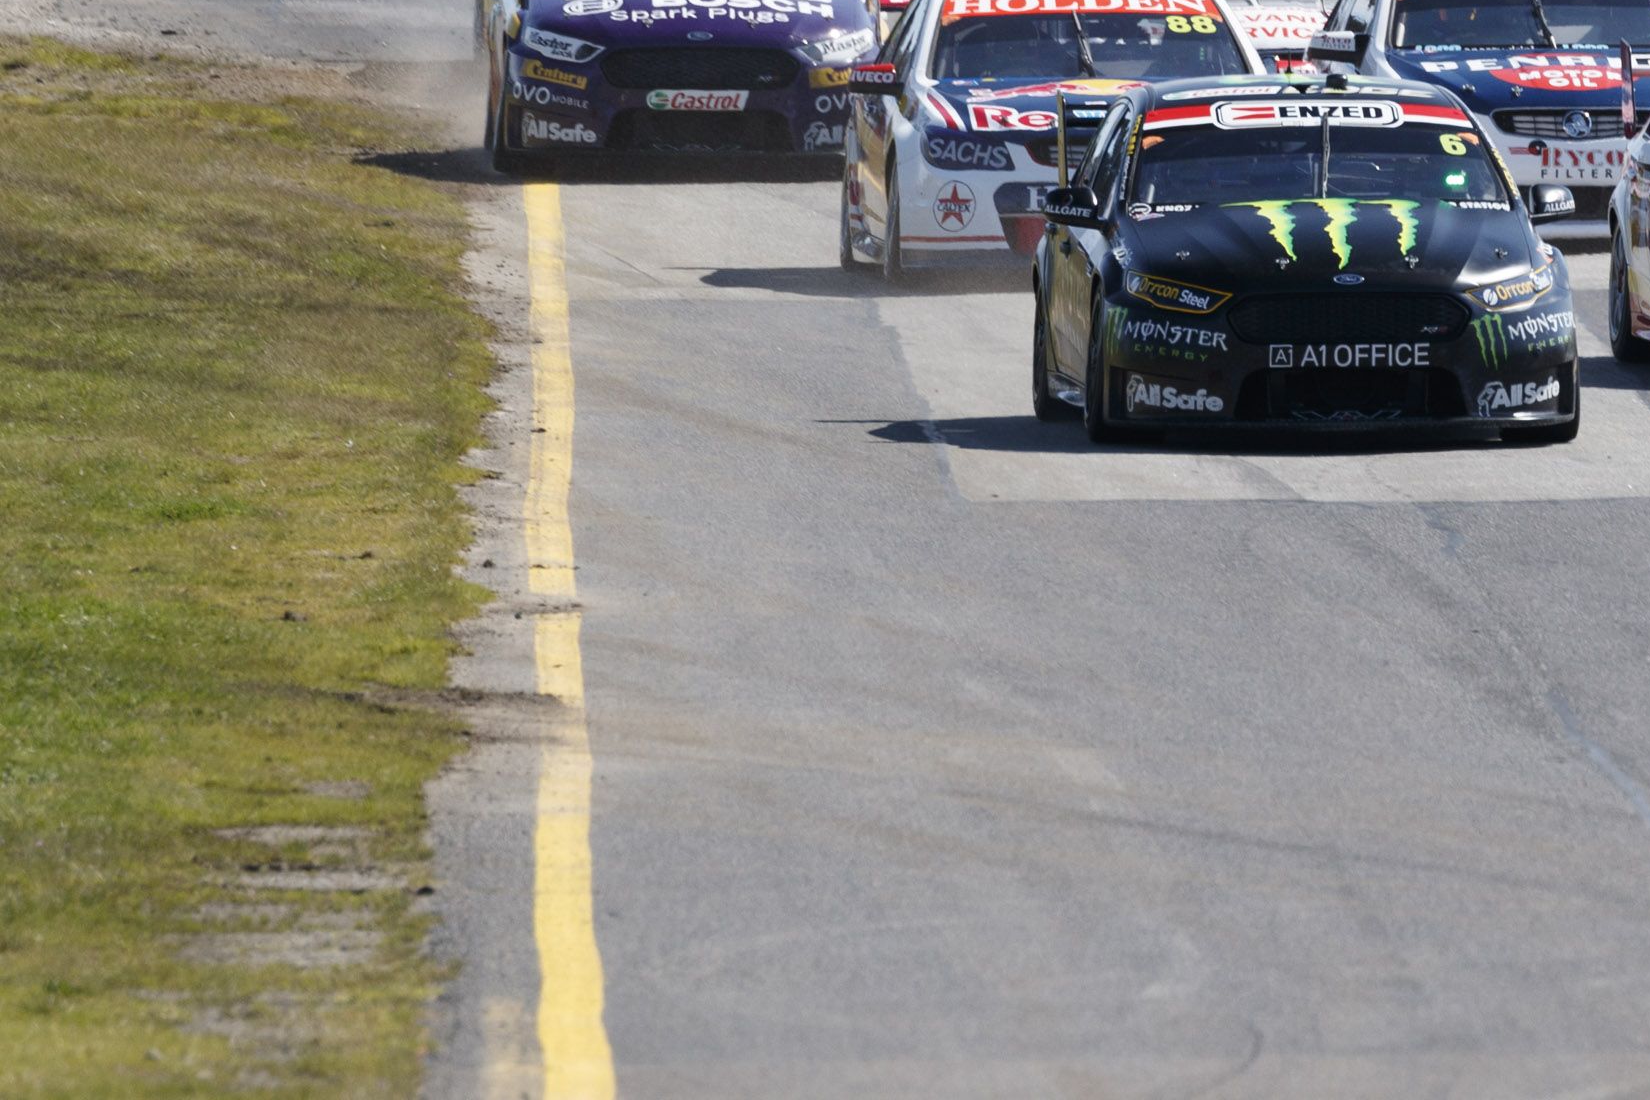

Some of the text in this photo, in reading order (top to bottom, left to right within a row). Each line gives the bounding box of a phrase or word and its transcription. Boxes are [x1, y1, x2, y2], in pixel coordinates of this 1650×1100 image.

[609, 5, 790, 27] Spark Plugs
[1165, 14, 1217, 34] 88
[851, 71, 894, 83] IVECO
[1518, 69, 1623, 81] MOTOR
[1549, 77, 1598, 88] OIL
[512, 81, 551, 104] OVO
[670, 92, 742, 109] Castrol
[1279, 105, 1384, 119] ENZED
[927, 138, 1008, 169] SACHS
[1438, 133, 1467, 156] 6
[1541, 148, 1624, 167] RYCO
[937, 203, 971, 213] CALTEX
[1044, 204, 1093, 218] ALLGATE
[1139, 277, 1180, 300] Orrcon
[1495, 279, 1535, 301] Orrcon
[1178, 289, 1210, 309] Steel
[1124, 319, 1229, 352] MONSTER
[1508, 313, 1577, 341] MONSTER
[1134, 343, 1209, 363] ENERGY
[1300, 344, 1327, 368] A1
[1333, 342, 1431, 367] OFFICE
[1134, 383, 1224, 412] AllSafe
